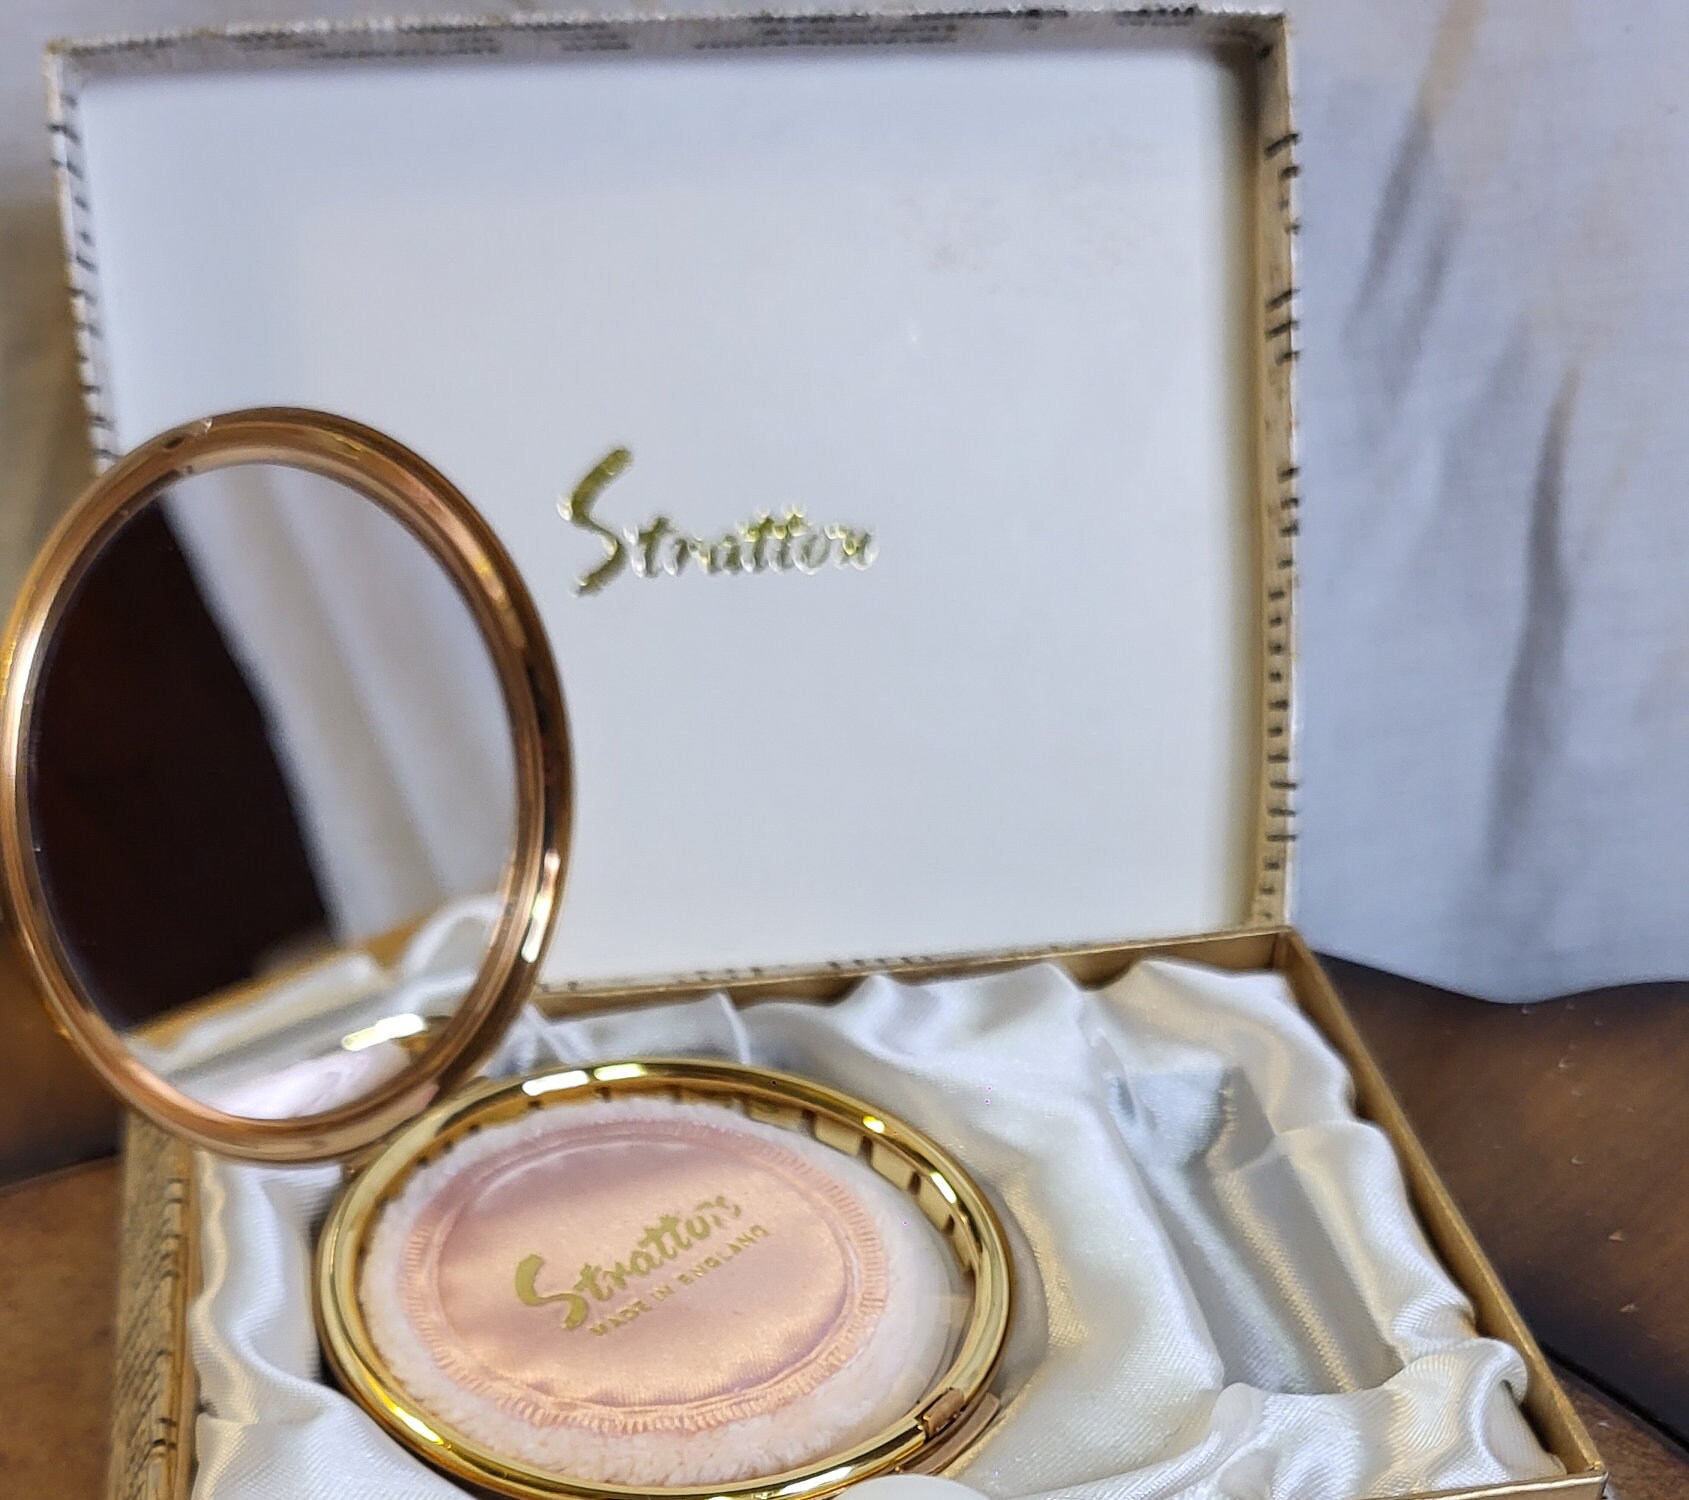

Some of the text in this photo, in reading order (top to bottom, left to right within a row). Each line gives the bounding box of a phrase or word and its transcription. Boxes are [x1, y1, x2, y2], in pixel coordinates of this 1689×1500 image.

[556, 448, 878, 597] Stratton
[514, 1195, 741, 1331] Stratton
[589, 1300, 651, 1337] MADE
[650, 1284, 676, 1302] IN
